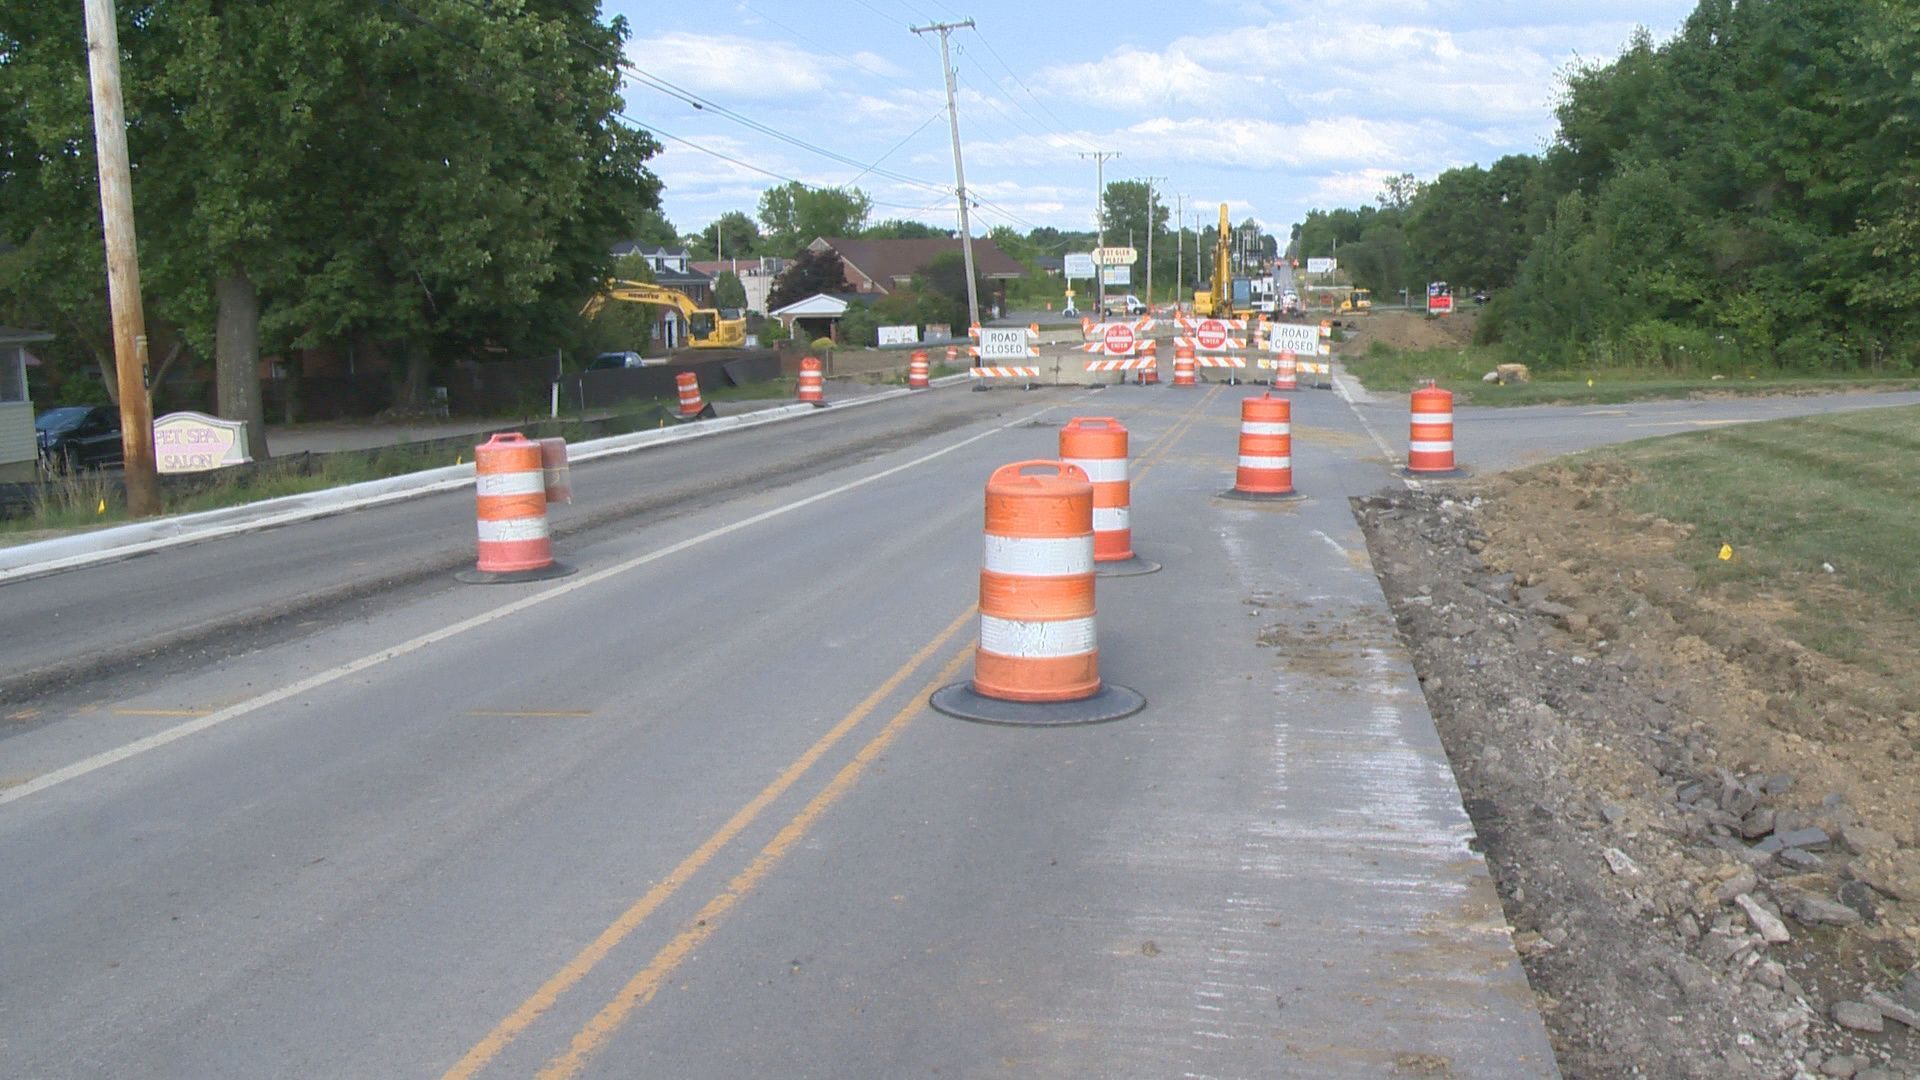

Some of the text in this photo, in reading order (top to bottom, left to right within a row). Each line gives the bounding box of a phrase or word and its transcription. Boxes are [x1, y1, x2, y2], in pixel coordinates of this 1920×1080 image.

[991, 333, 1018, 342] ROAD
[1281, 328, 1309, 339] ROAD
[985, 344, 1022, 353] CLOSED
[1275, 339, 1313, 351] CLOSED
[156, 429, 220, 444] PET SPA
[165, 455, 213, 469] SALON
